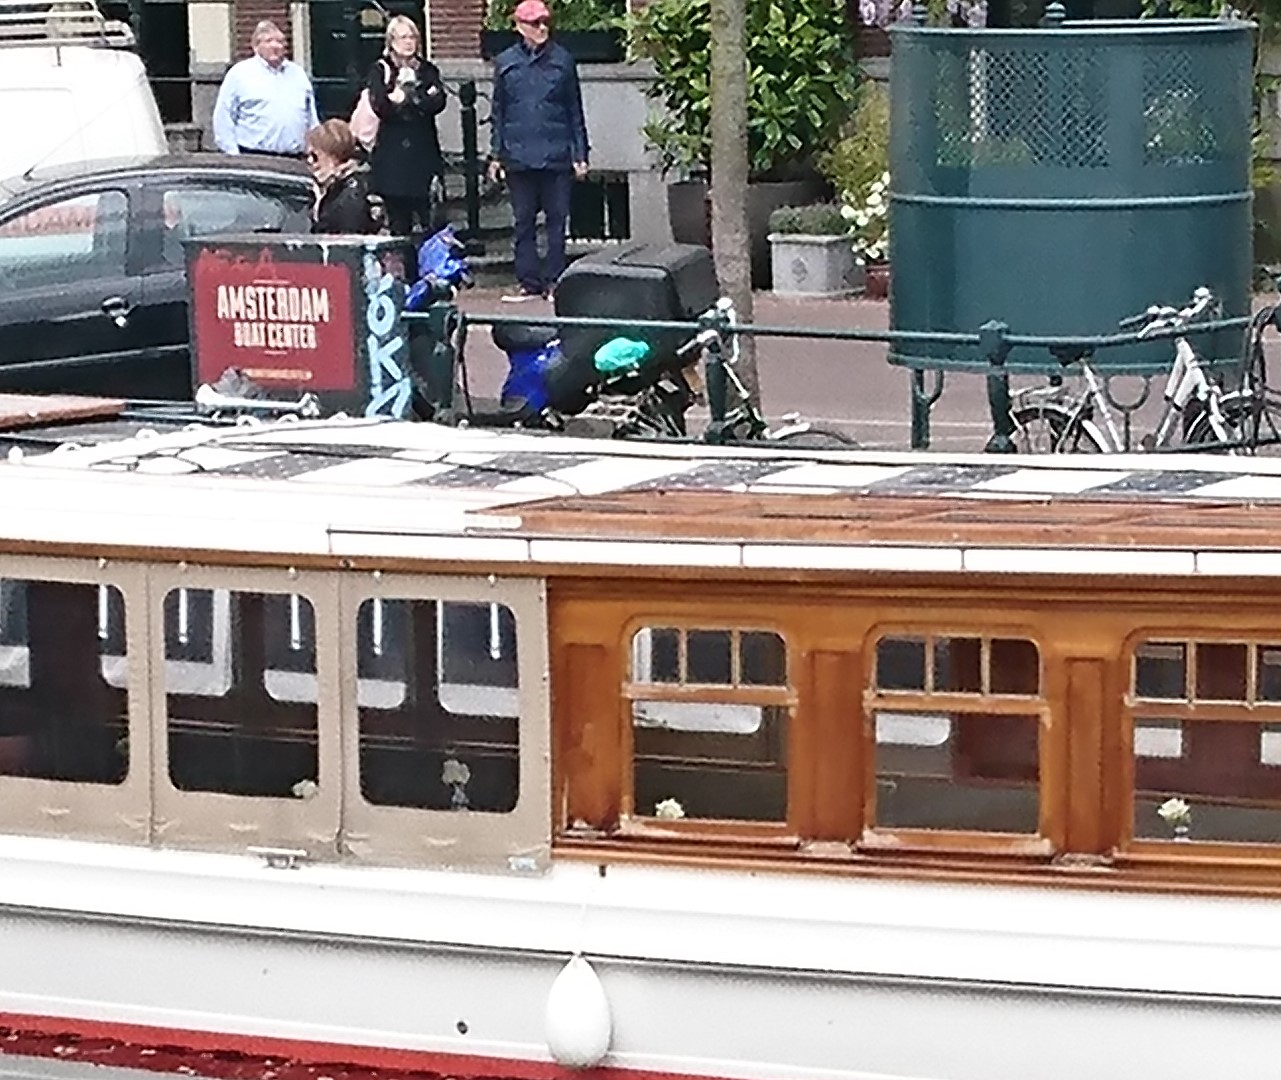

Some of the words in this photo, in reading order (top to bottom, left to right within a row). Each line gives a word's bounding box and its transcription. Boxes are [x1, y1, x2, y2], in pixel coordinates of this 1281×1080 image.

[217, 284, 330, 323] AMSTERDAM
[233, 321, 266, 348] BOAT
[267, 322, 317, 349] CENTER
